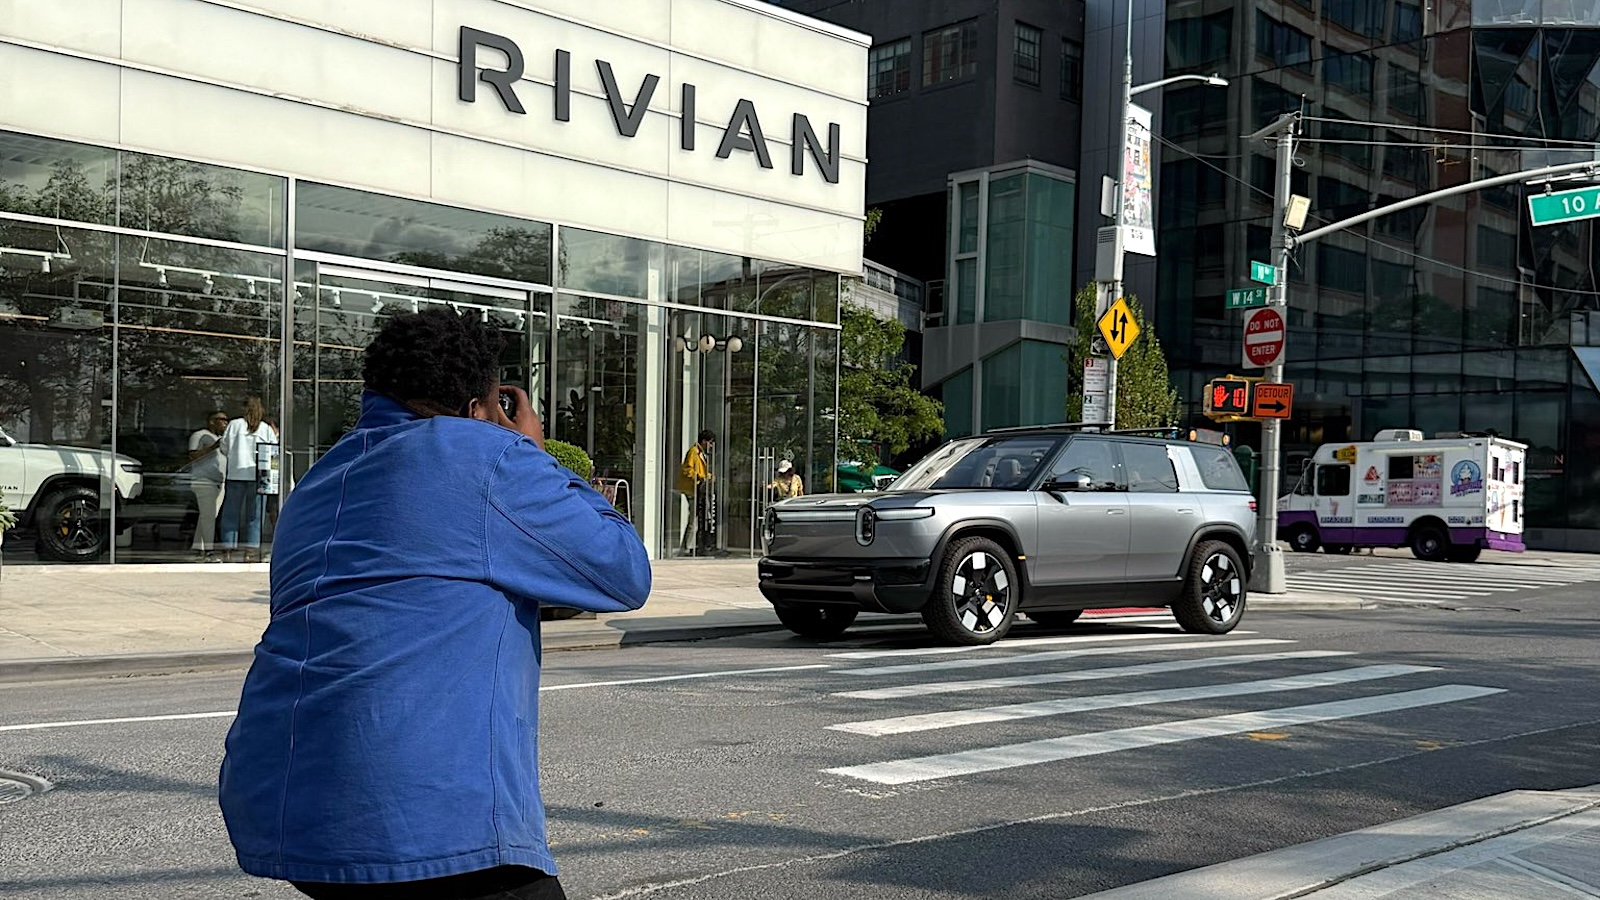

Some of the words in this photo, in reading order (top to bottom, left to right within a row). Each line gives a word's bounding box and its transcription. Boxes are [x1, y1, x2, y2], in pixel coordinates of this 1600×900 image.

[458, 25, 841, 184] RIVIAN
[1562, 196, 1585, 214] 10
[1232, 292, 1240, 306] W
[1243, 291, 1253, 305] 14
[1249, 321, 1260, 331] DO
[1264, 318, 1280, 329] NOT
[1251, 344, 1275, 356] ENTER
[1232, 388, 1245, 408] 10
[1257, 387, 1289, 399] DETOUR
